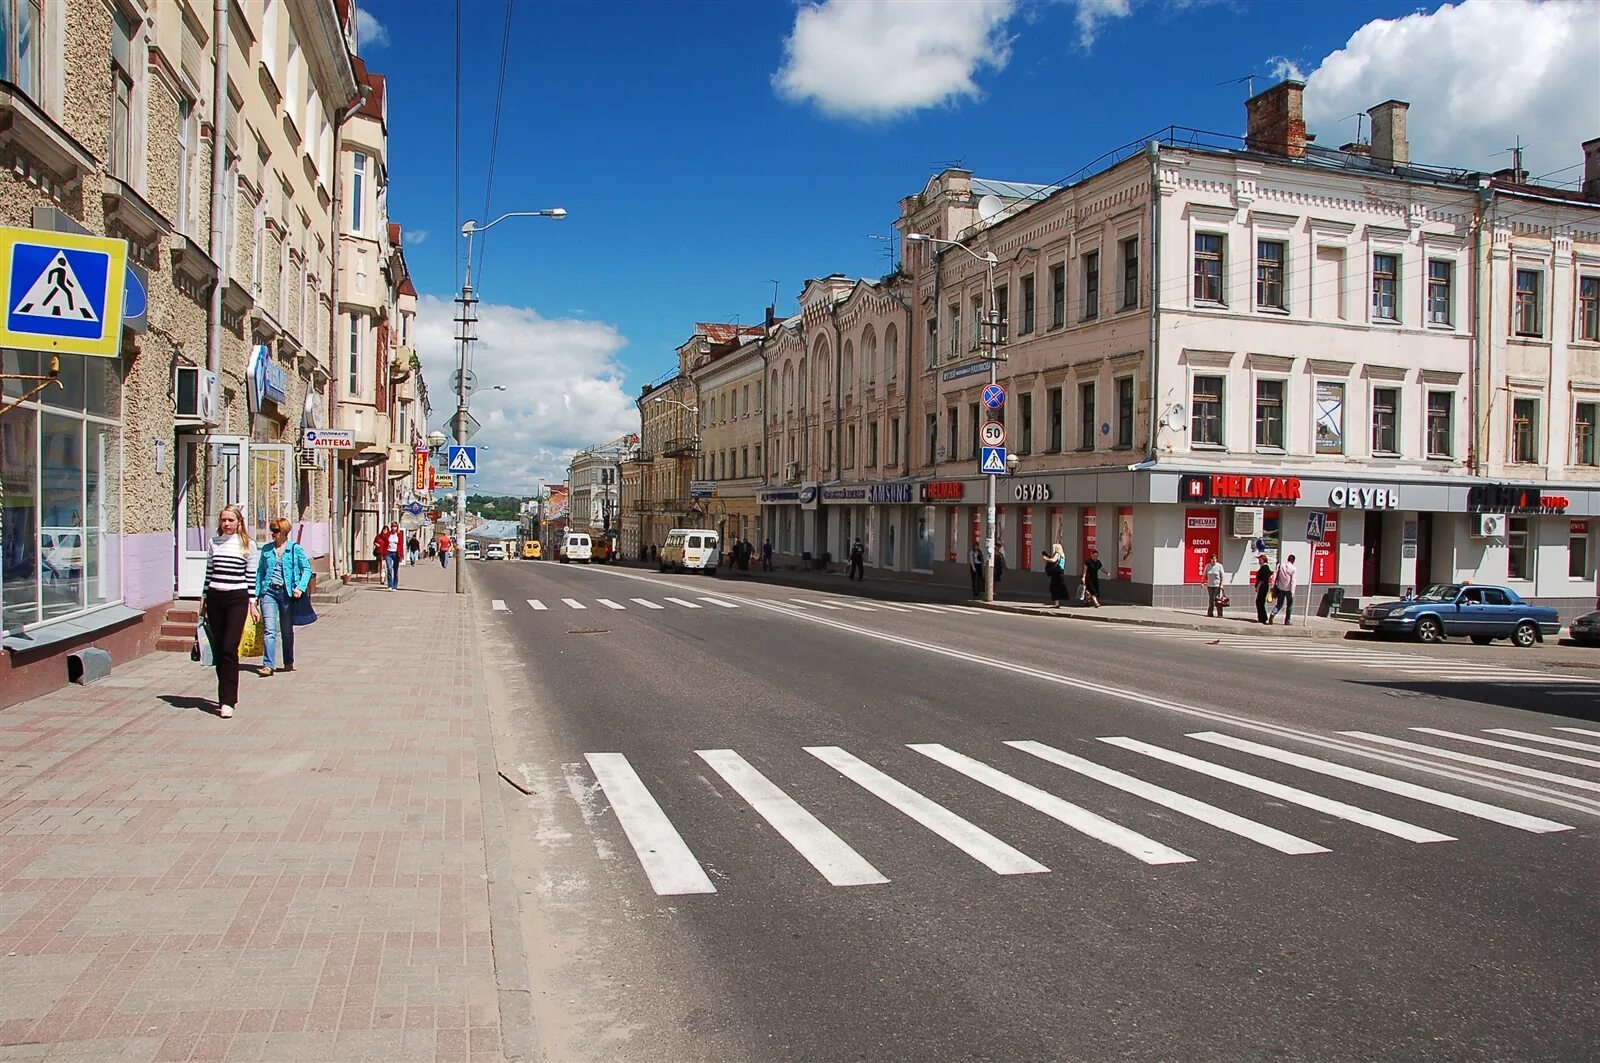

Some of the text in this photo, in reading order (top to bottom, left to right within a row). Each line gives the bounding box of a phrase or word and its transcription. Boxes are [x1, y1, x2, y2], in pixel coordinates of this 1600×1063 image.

[315, 438, 351, 447] АПТЕКА
[986, 428, 1001, 439] 50
[868, 483, 910, 502] SAMSUNG
[928, 481, 962, 499] HELMAR
[1014, 483, 1050, 500] ОБУВЬ
[1212, 474, 1301, 499] HELMAR
[1331, 486, 1399, 507] ОБУВЬ
